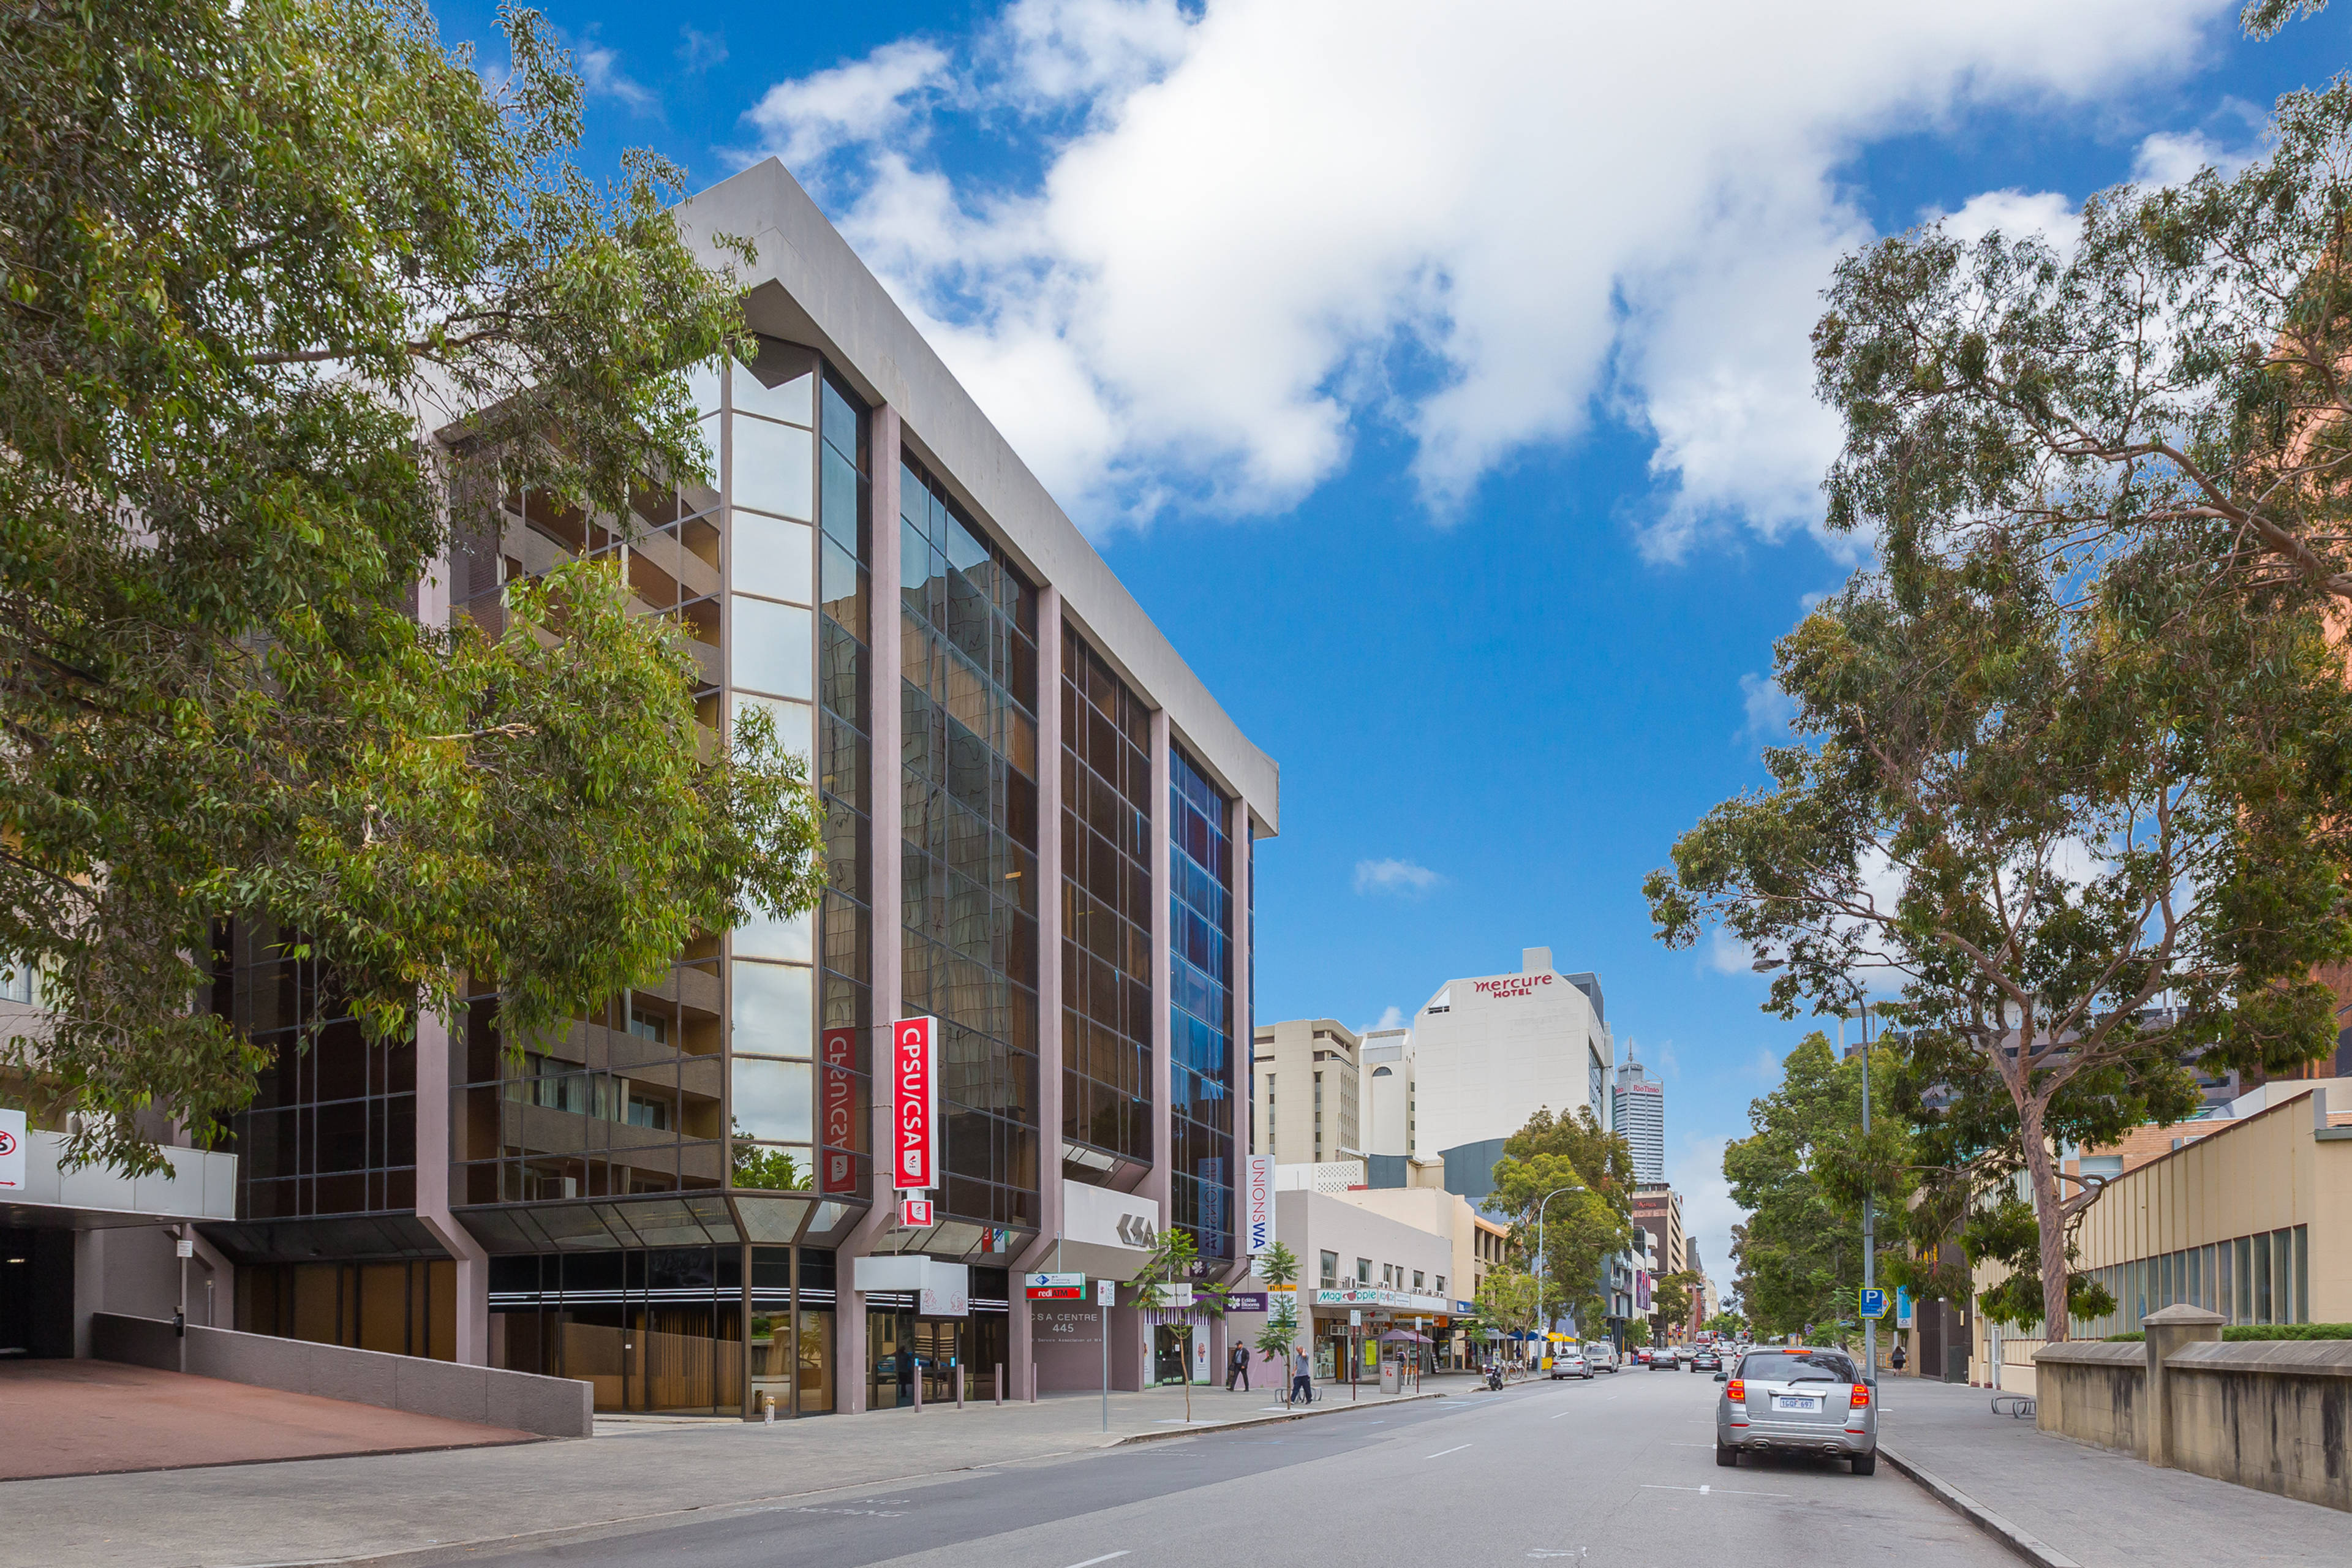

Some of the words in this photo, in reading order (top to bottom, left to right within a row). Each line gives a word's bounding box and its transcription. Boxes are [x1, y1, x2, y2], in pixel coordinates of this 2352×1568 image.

[1473, 974, 1553, 992] mercure
[1493, 988, 1532, 998] HOTEL
[902, 1028, 922, 1148] CPSU/CSA
[1252, 1159, 1265, 1249] UNIONSWA
[1866, 1291, 1879, 1303] P
[1052, 1324, 1074, 1332] 445
